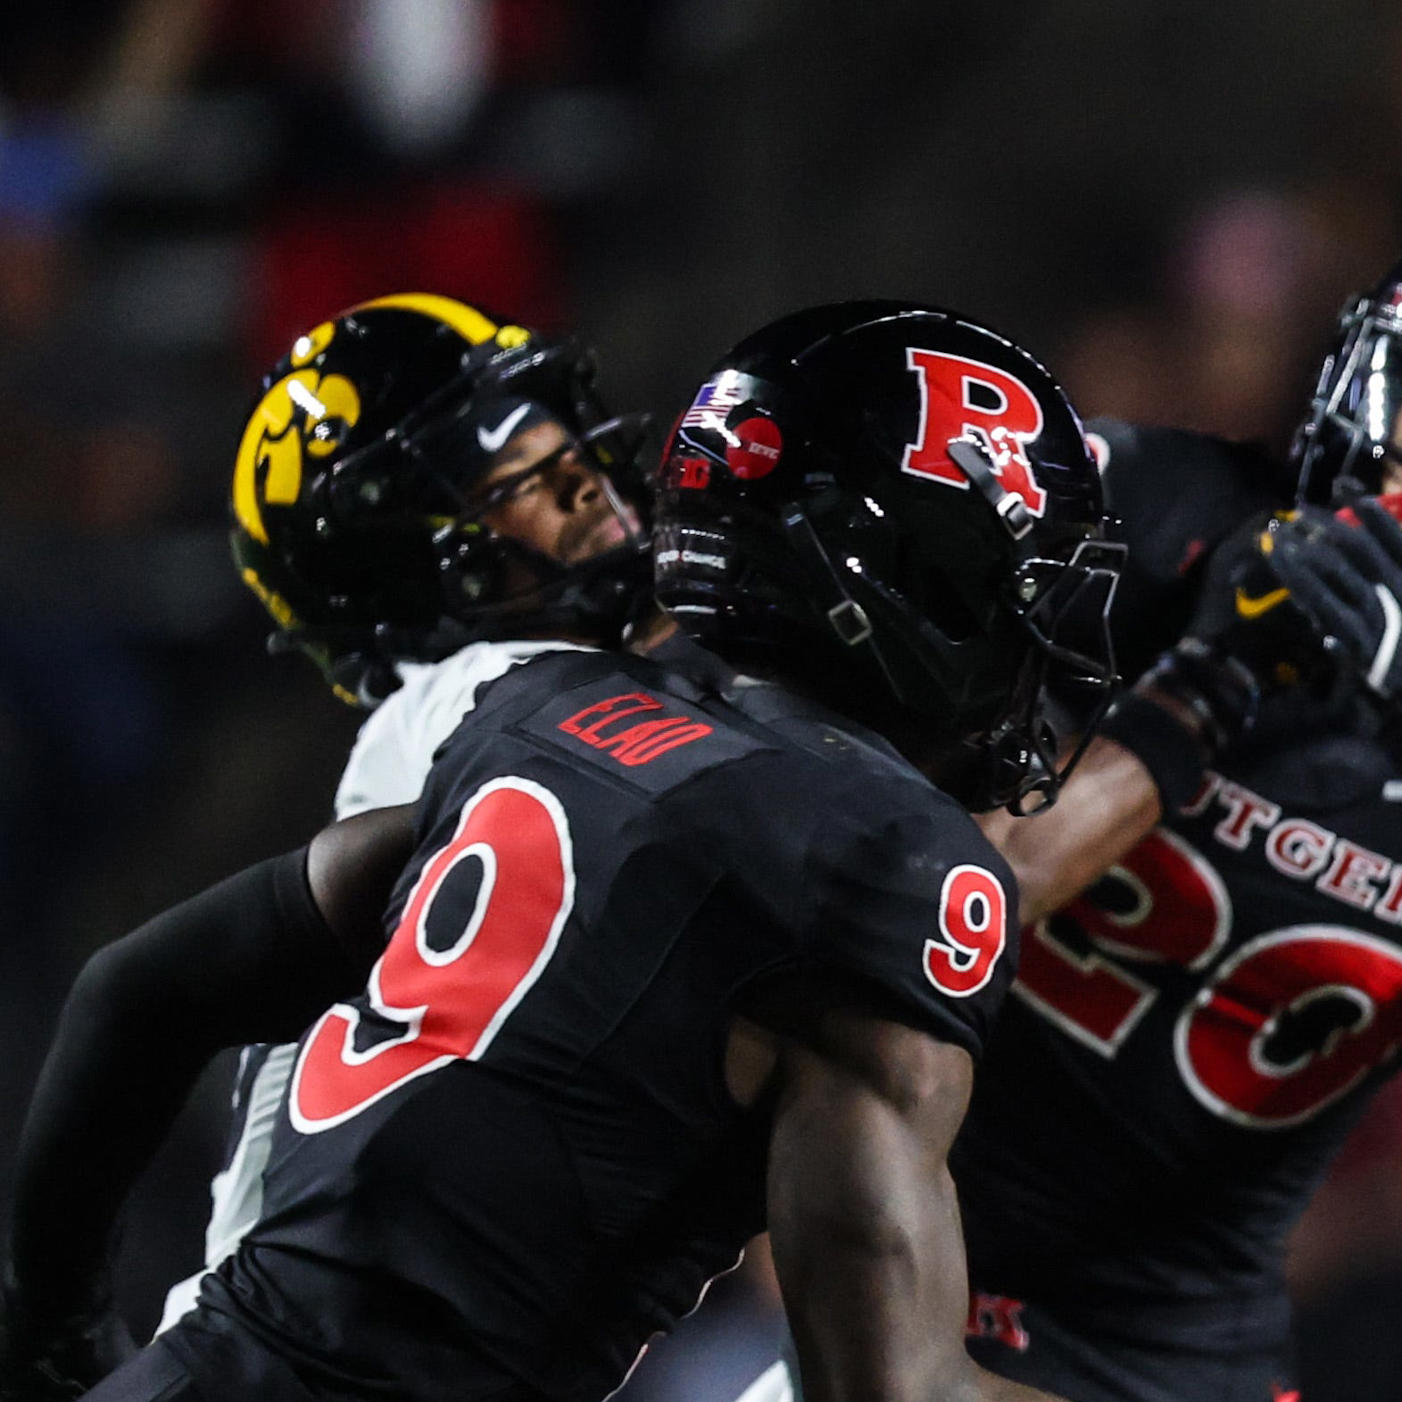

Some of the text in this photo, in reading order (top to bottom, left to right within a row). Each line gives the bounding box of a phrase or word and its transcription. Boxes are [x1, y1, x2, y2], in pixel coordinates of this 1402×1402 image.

[902, 347, 1047, 519] R
[289, 776, 576, 1135] 9
[923, 864, 1007, 998] 9
